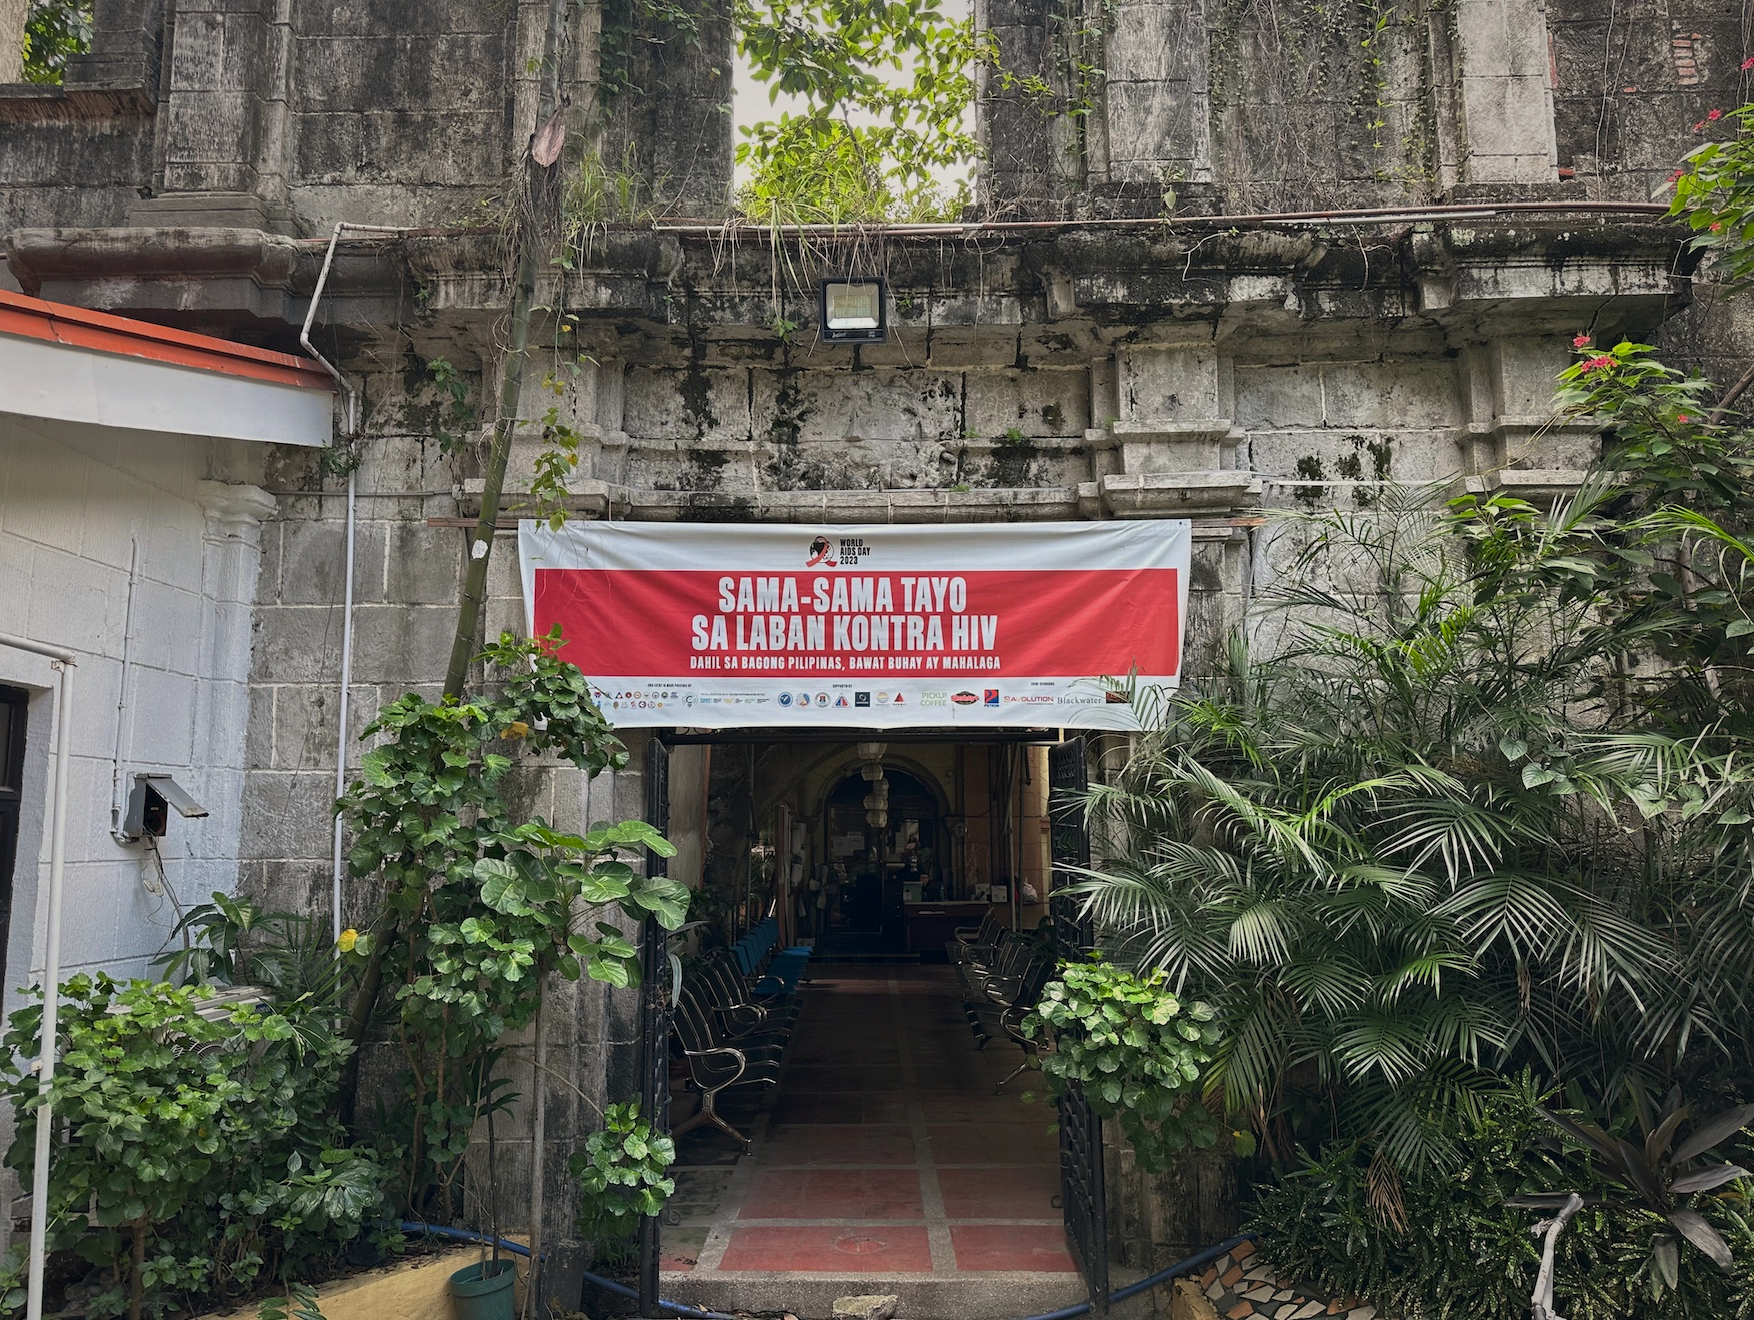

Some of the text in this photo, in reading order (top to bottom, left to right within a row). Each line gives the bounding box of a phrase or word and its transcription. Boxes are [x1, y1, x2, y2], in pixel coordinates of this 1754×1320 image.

[840, 538, 864, 547] WORLD
[840, 547, 871, 556] AIDS DAY
[840, 556, 858, 565] 2023
[718, 576, 967, 613] SAMA-SAMA TAYO
[691, 614, 998, 651] SA LABAN KONTRA HIV
[690, 656, 1001, 671] DAHIL SA BAGONG PILIPINAS, BAWAT BUHAY AY MAHALAGA
[920, 699, 947, 707] COFFEE
[1010, 695, 1054, 703] AVOLUTION
[1057, 696, 1102, 705] Blackwater
